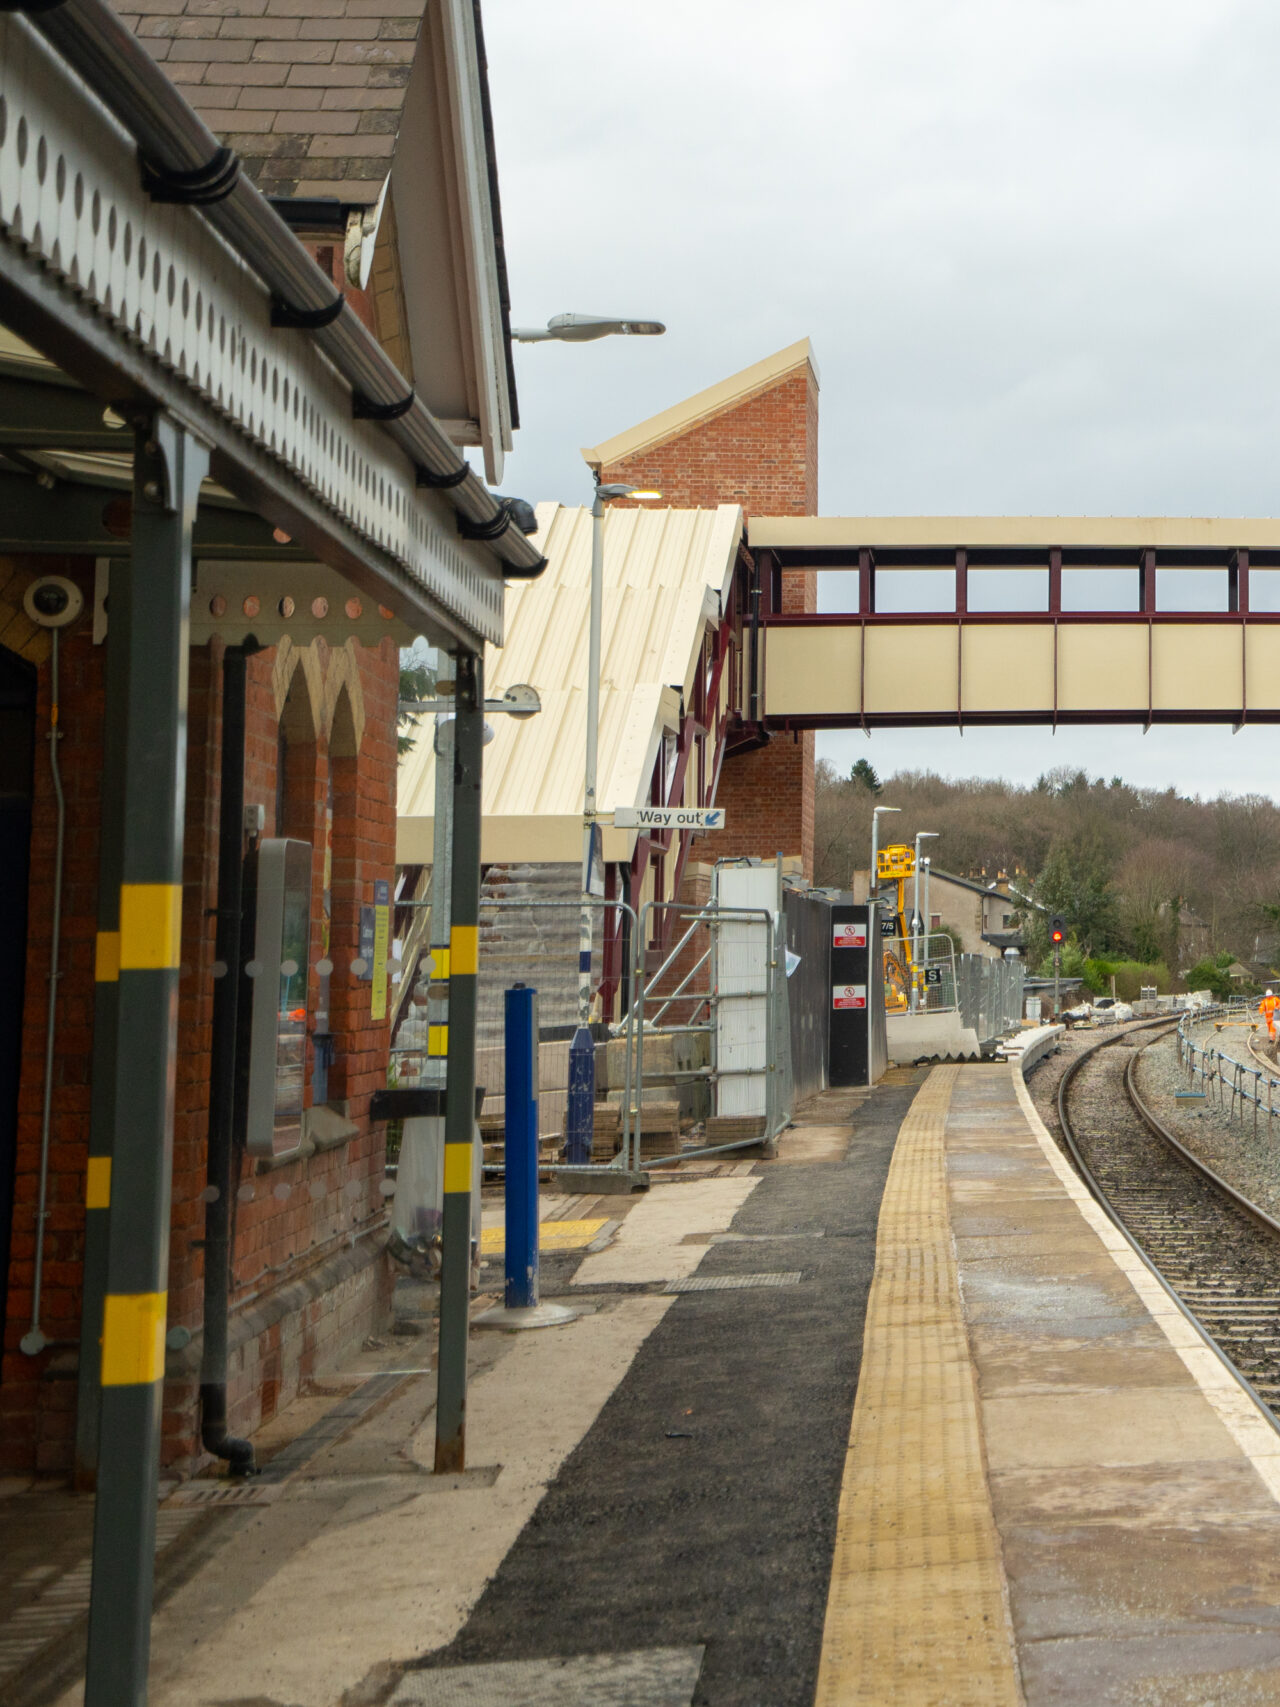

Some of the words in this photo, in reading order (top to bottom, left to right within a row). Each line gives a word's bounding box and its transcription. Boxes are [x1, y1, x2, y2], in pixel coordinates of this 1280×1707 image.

[640, 811, 671, 825] Way
[677, 812, 701, 824] out
[928, 970, 937, 981] S
